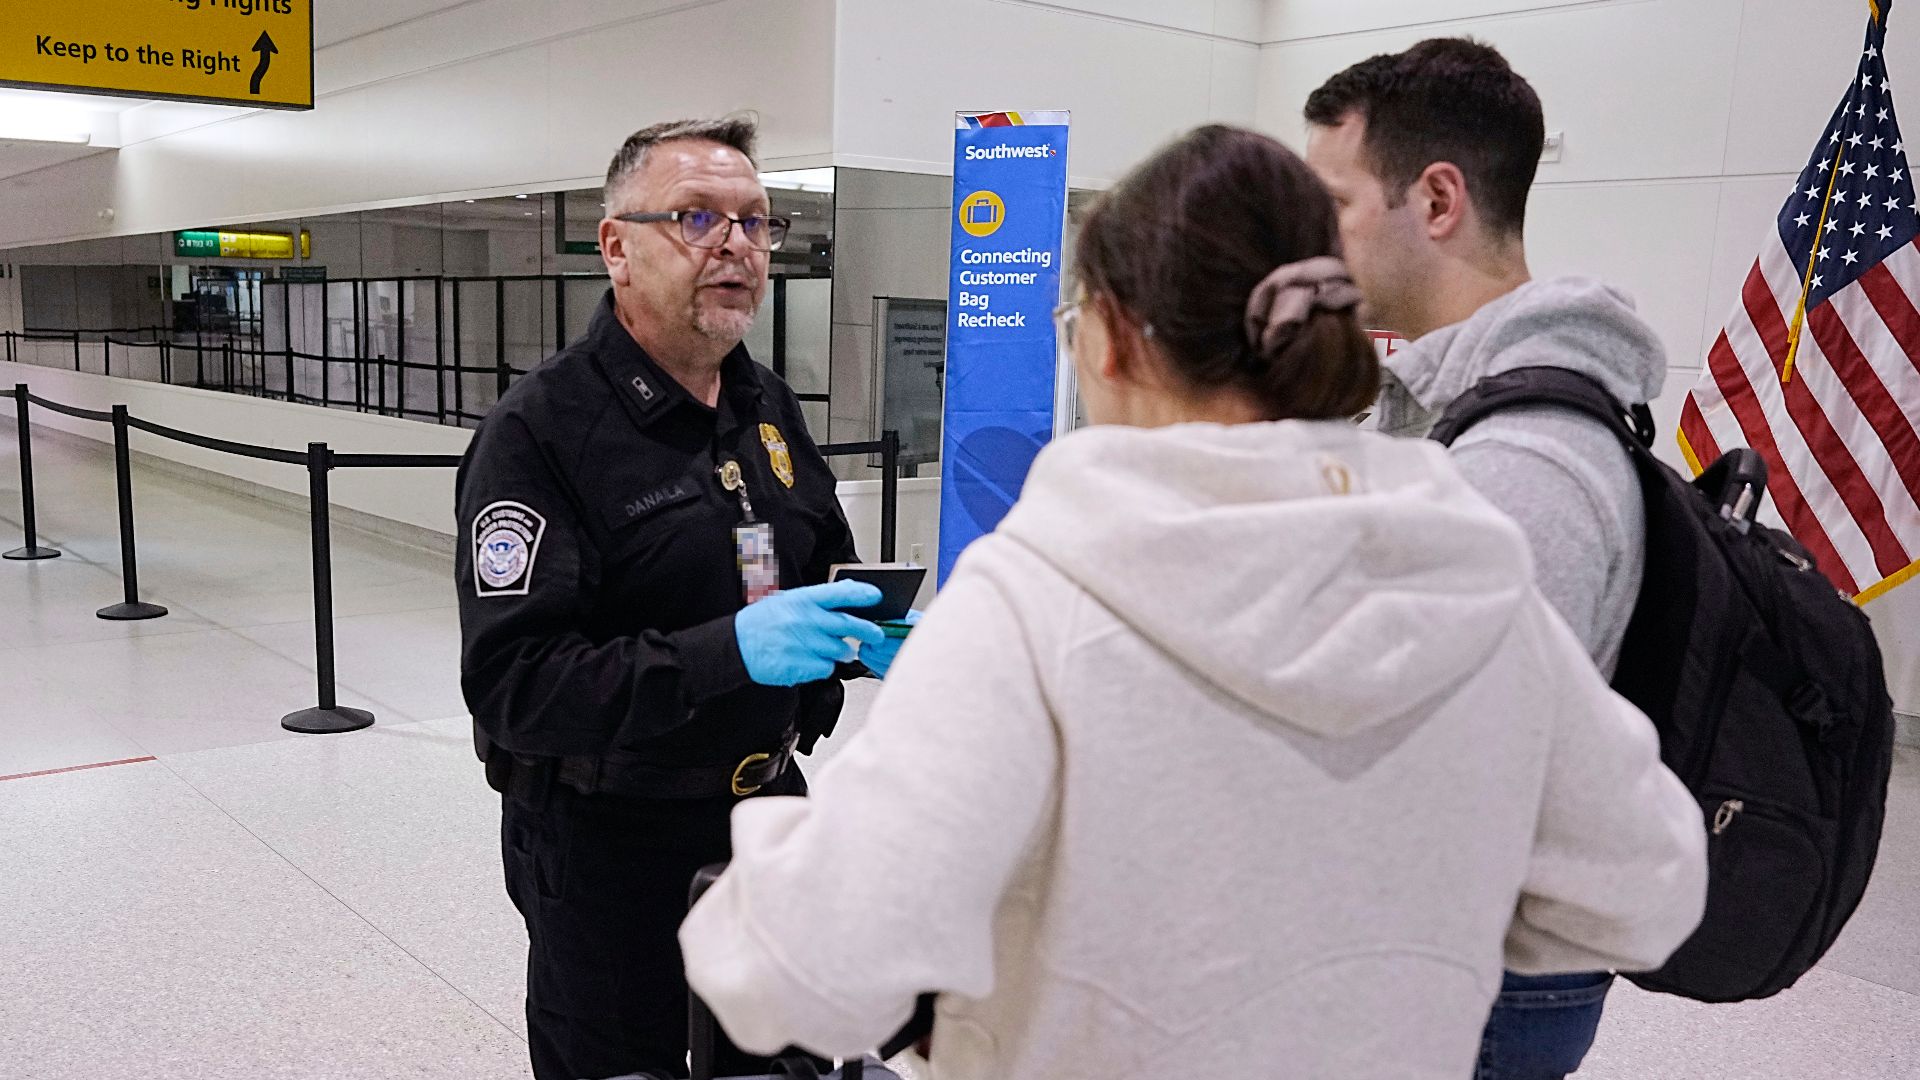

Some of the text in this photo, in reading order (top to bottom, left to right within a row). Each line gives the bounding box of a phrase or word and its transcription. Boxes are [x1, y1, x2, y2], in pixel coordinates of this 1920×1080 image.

[210, 0, 292, 15] ghts
[36, 35, 241, 75] Keep to the Right
[965, 143, 1049, 160] Southwest
[960, 248, 1051, 267] Connecting
[959, 270, 1037, 285] Customer
[958, 292, 989, 309] Bag
[957, 312, 1025, 327] Recheck
